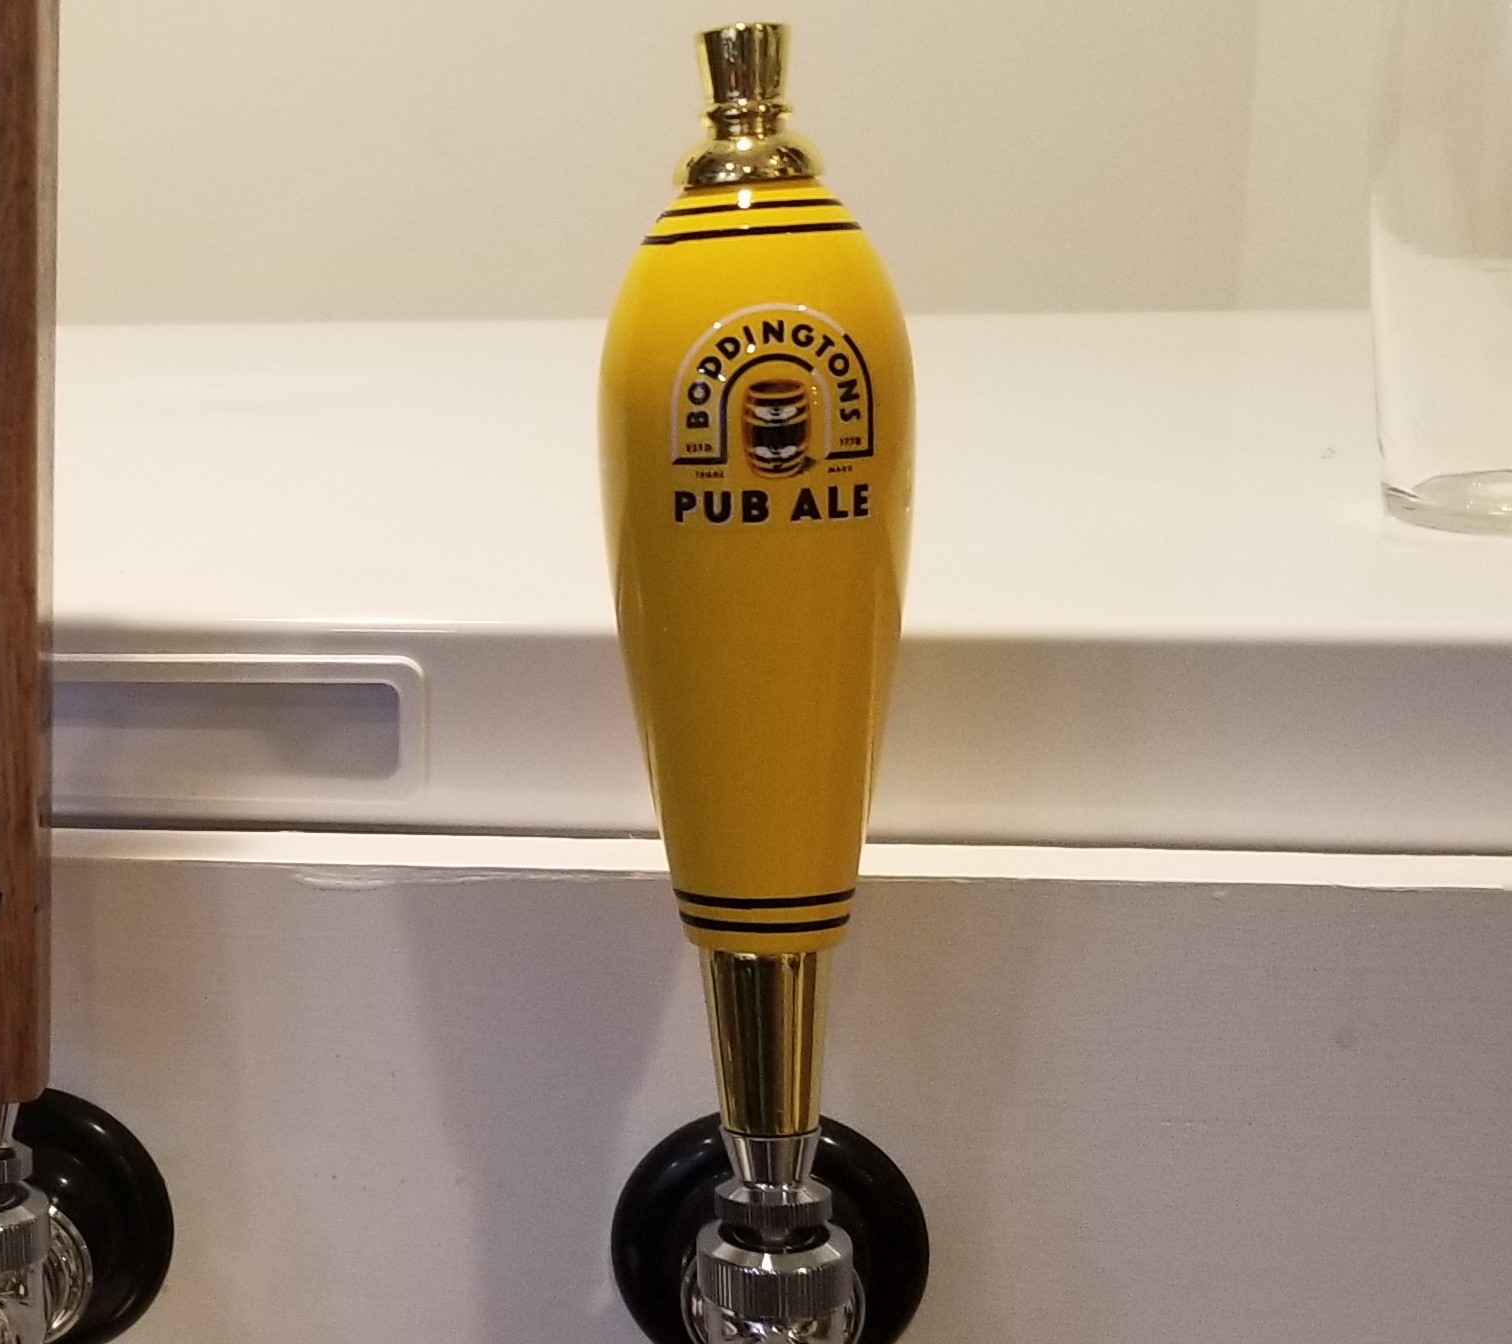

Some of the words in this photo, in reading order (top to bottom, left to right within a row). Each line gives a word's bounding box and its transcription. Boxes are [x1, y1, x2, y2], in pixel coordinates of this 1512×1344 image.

[686, 319, 862, 429] BODDINGTONS
[673, 490, 770, 525] PUB
[790, 483, 870, 522] ALE
